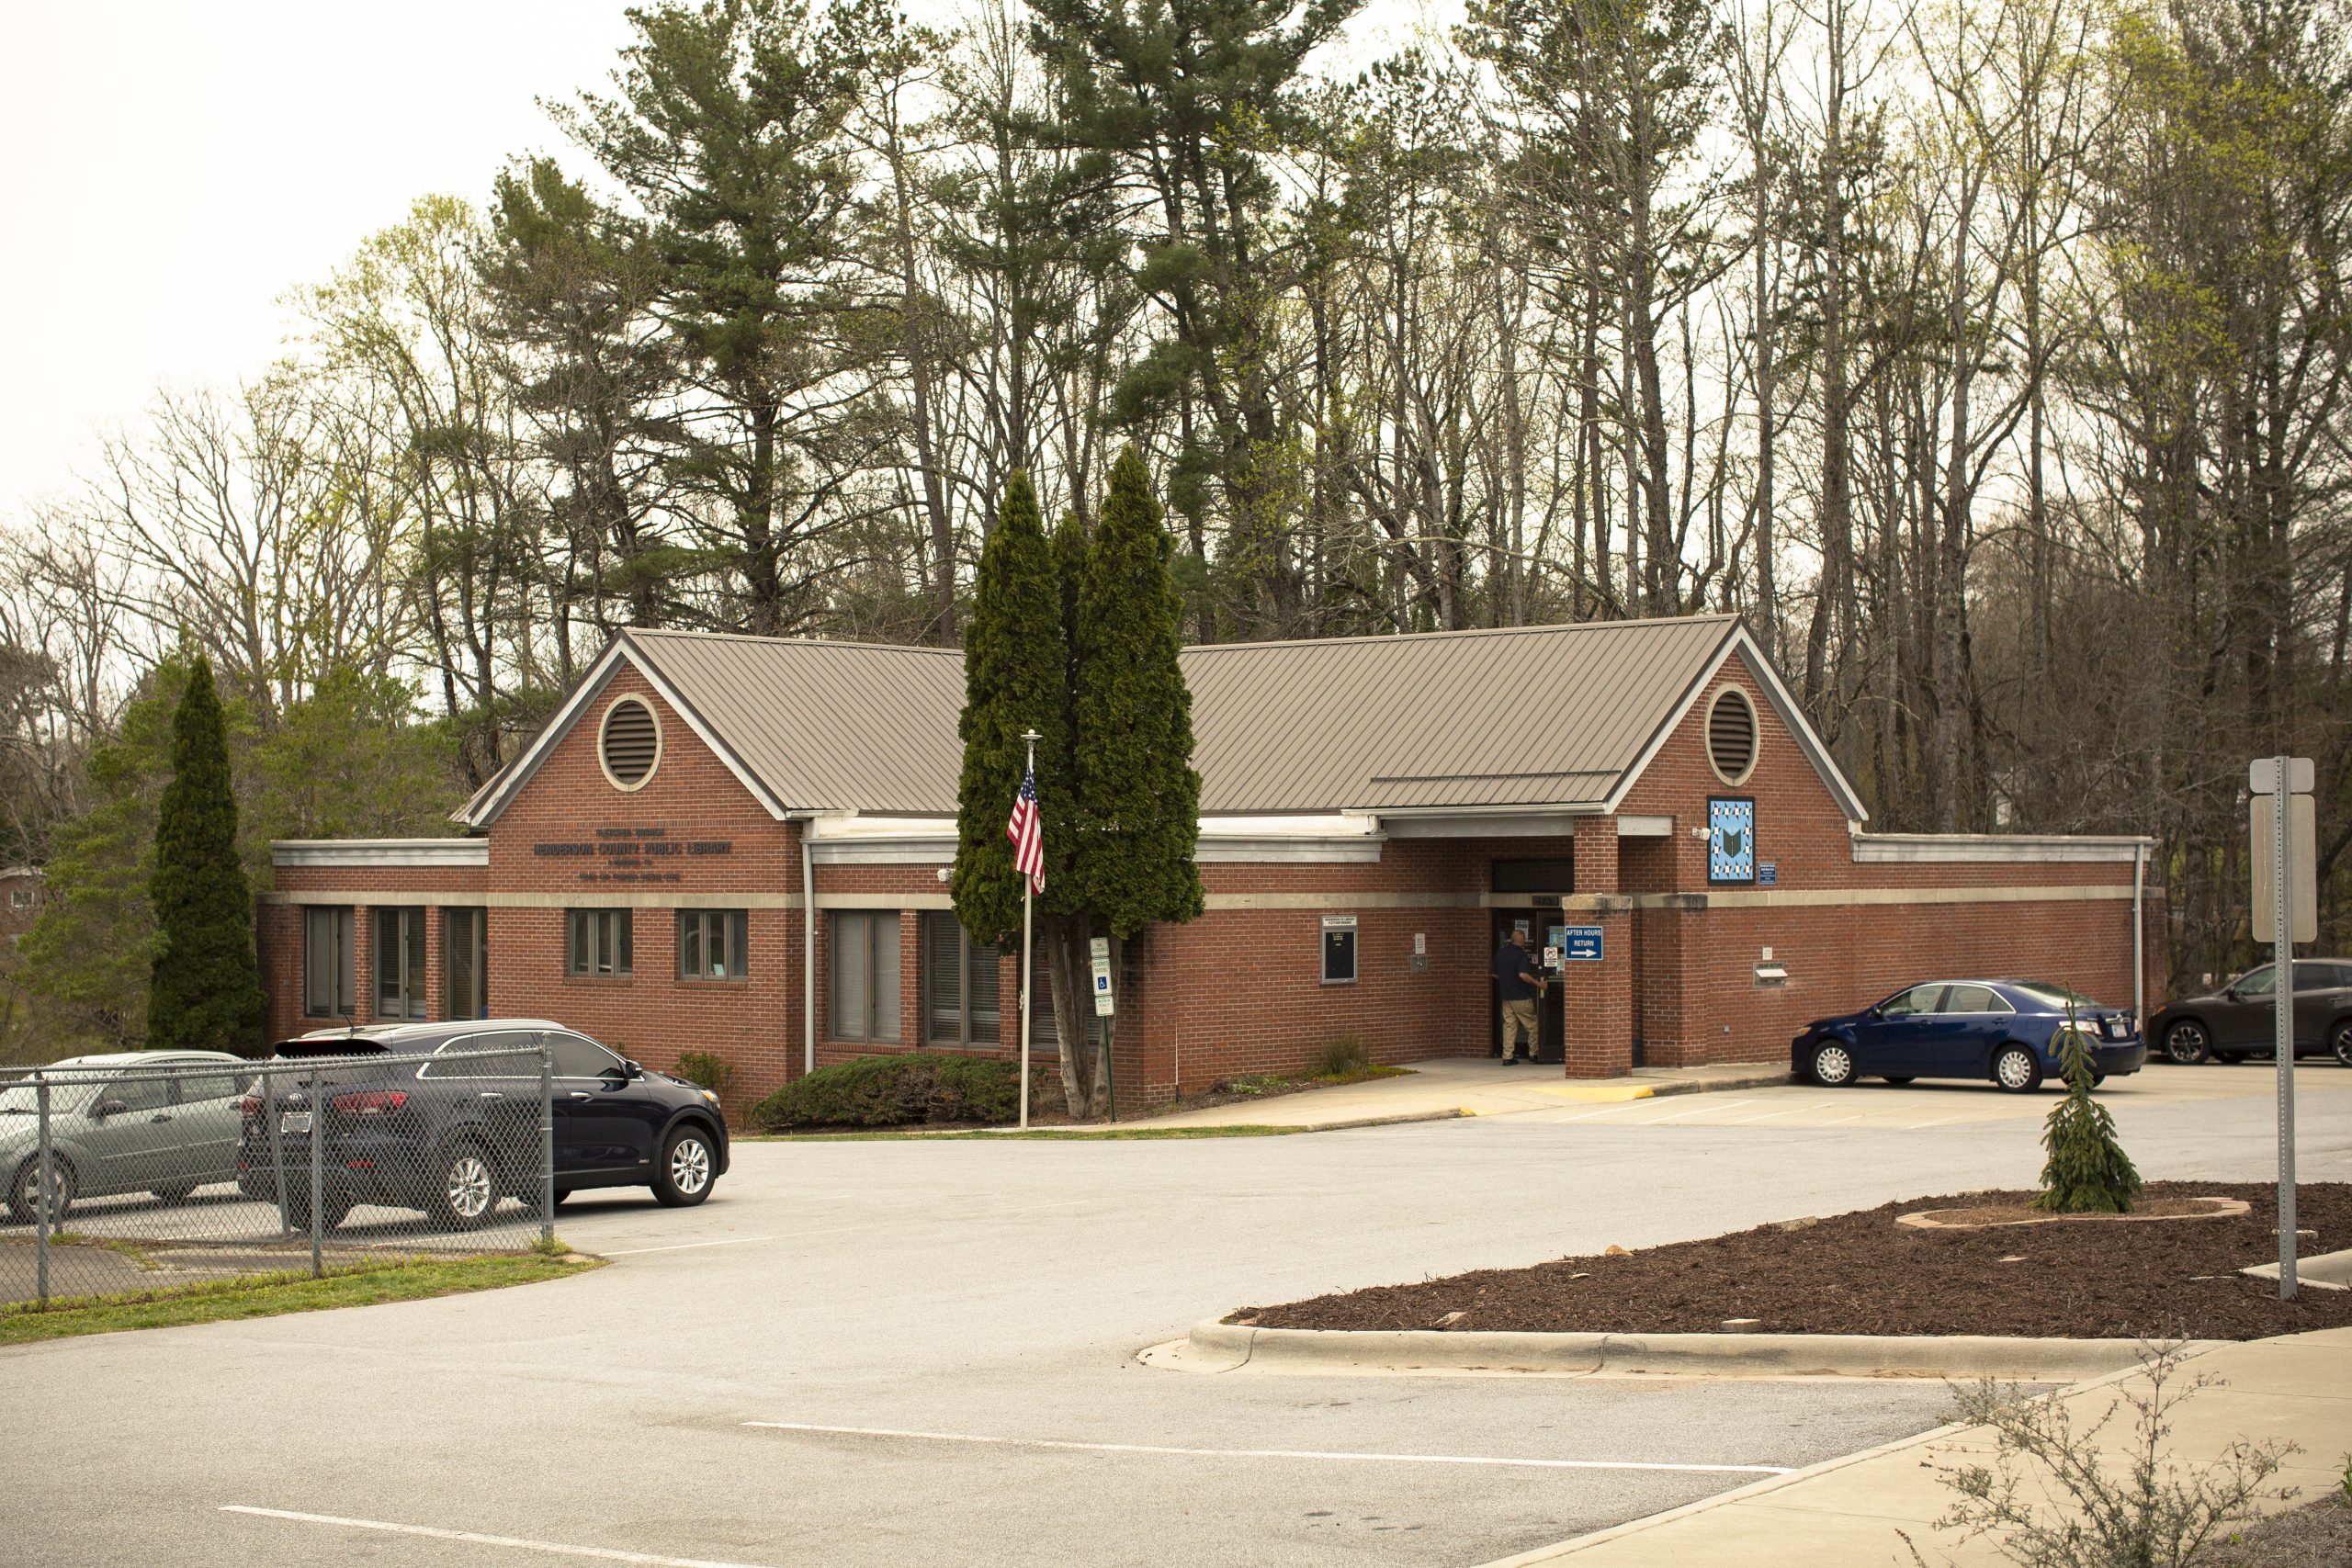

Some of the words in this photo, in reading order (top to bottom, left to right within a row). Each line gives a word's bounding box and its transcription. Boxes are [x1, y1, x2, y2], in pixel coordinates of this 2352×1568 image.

[534, 843, 593, 855] HENDERSON
[598, 842, 639, 855] COUNTY
[644, 841, 682, 854] PUBLIC
[686, 840, 731, 854] LIBRARY
